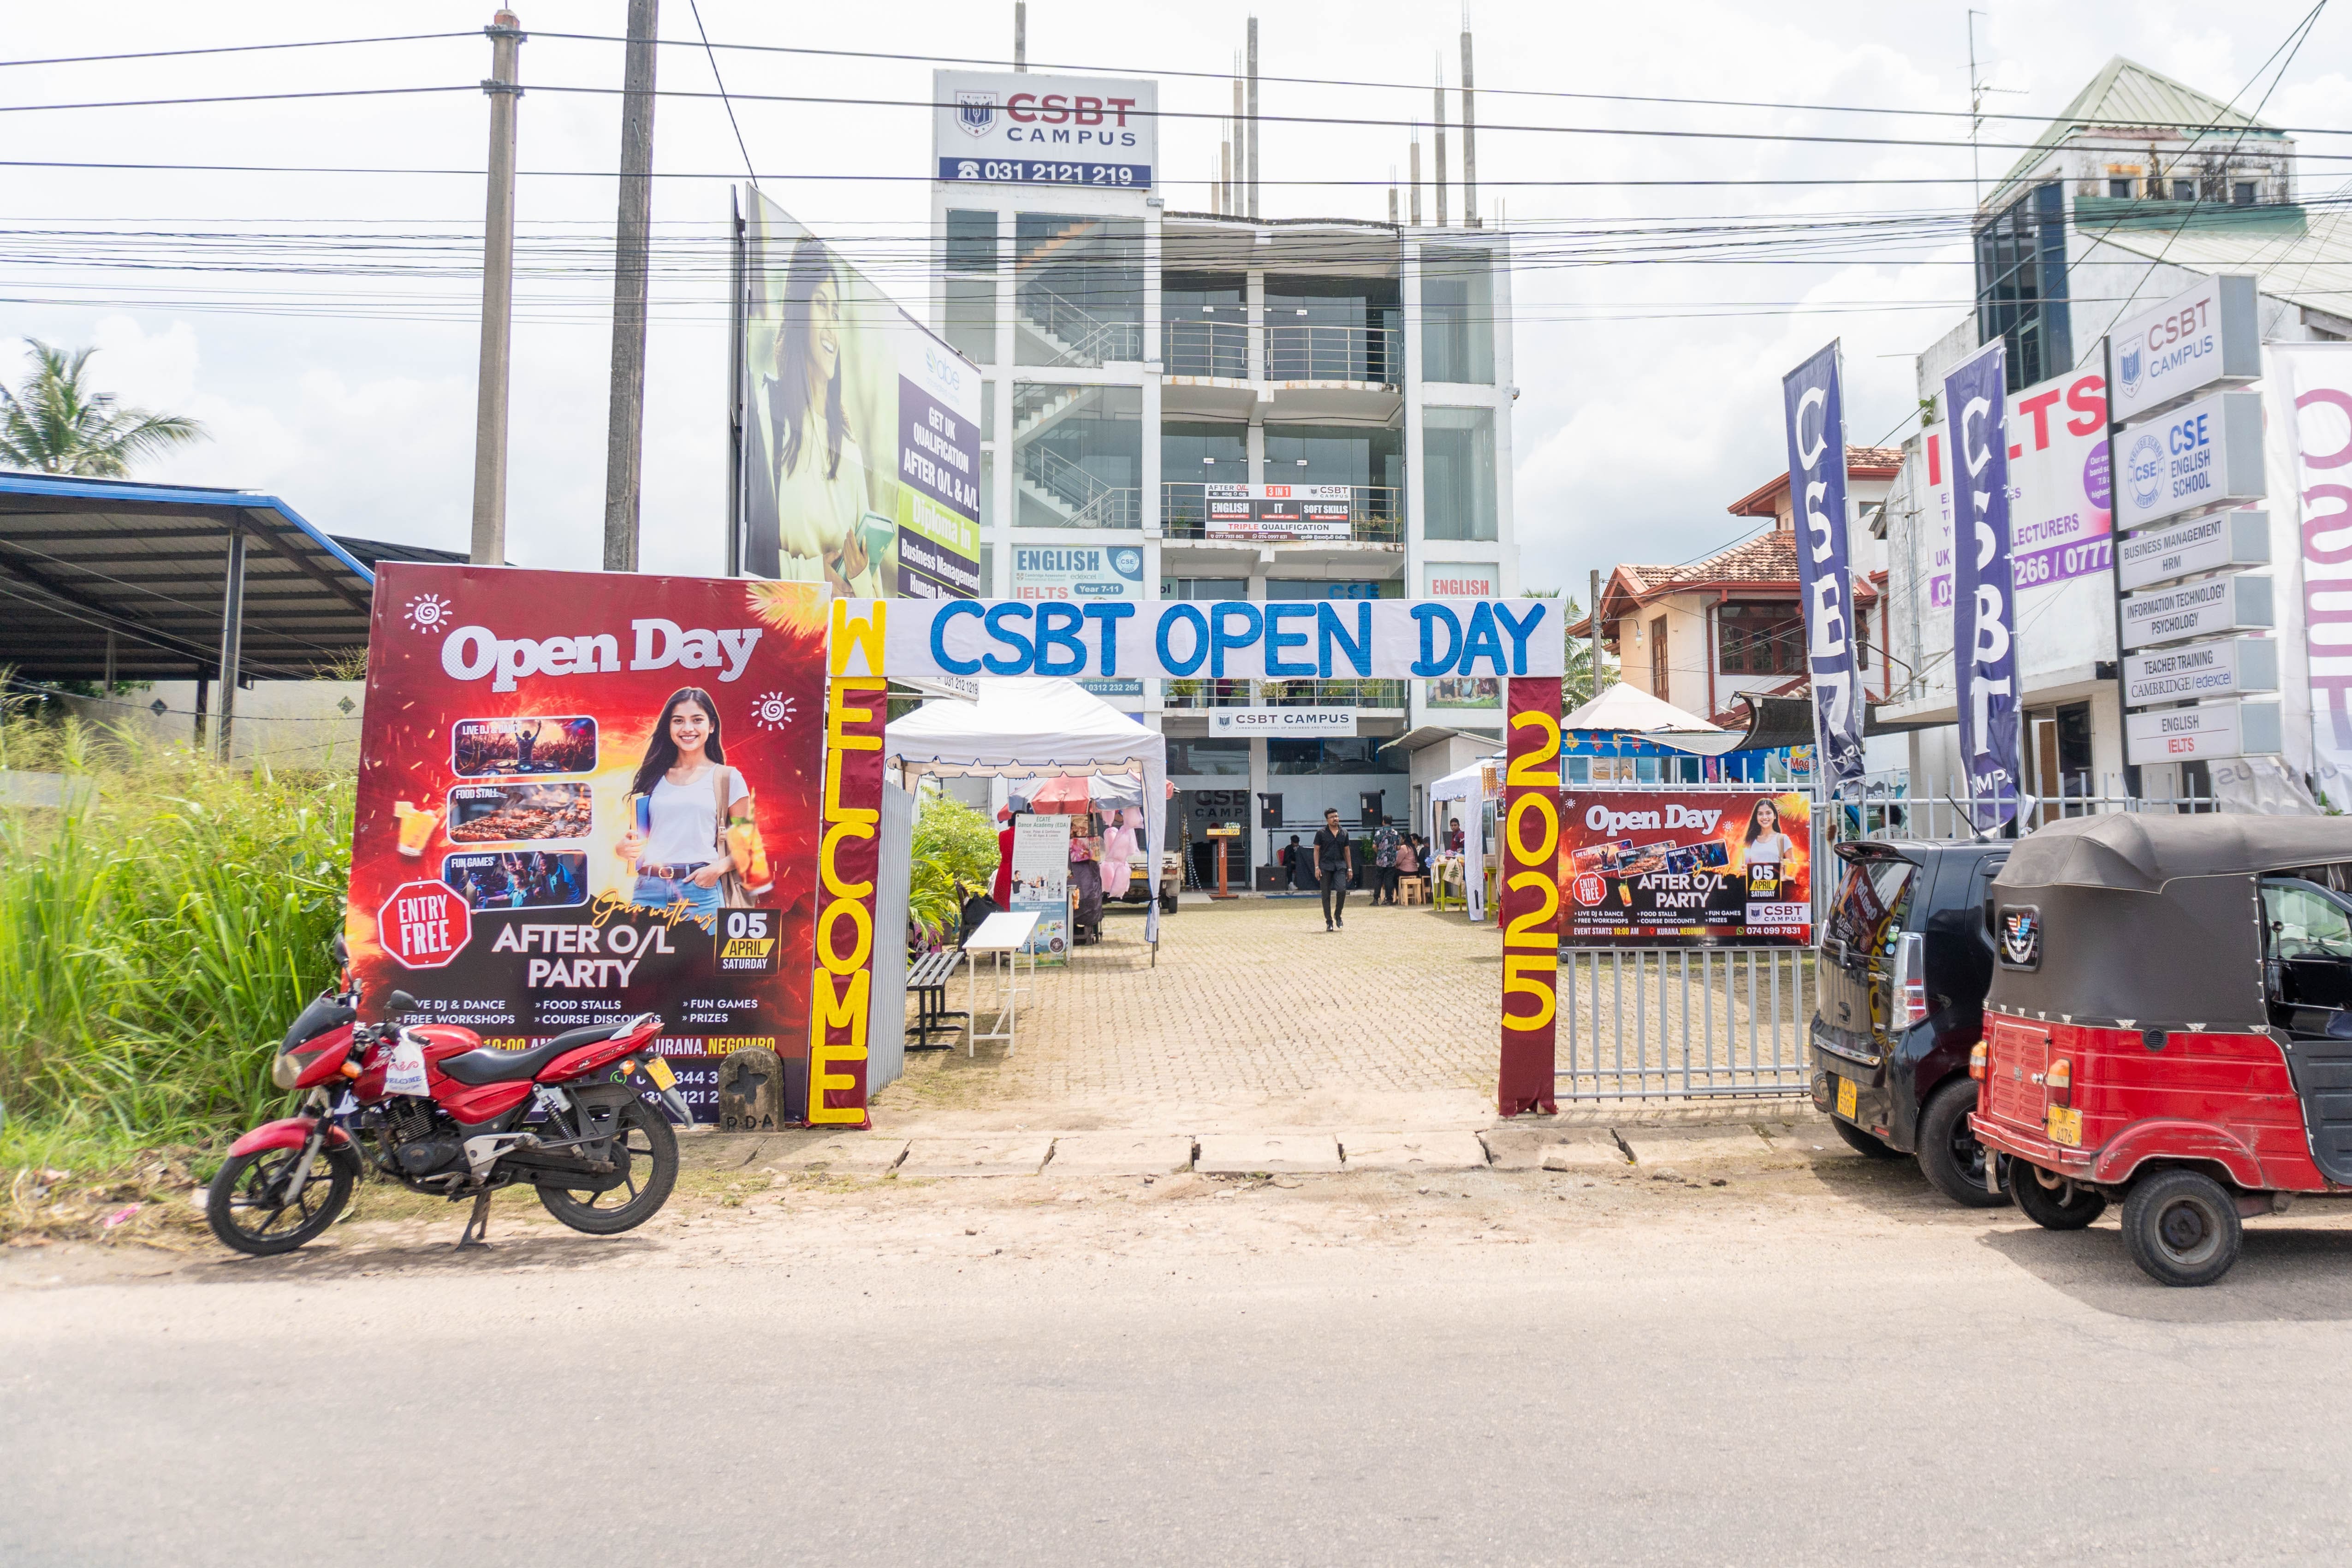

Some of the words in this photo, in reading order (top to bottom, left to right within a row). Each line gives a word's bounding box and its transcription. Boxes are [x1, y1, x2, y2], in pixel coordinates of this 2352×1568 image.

[1007, 93, 1135, 127] CSBT
[1007, 127, 1136, 146] CAMPUS
[985, 162, 1023, 180] 031
[1033, 165, 1083, 182] 2121
[1093, 166, 1133, 185] 219
[2149, 297, 2211, 351] CSBT
[2150, 335, 2214, 378] CAMPUS
[929, 406, 944, 433] GET
[945, 417, 956, 441] UK
[2169, 413, 2210, 457] CSE
[913, 422, 969, 474] QUALIFICATION
[2091, 456, 2100, 465] Our
[2171, 448, 2210, 474] ENGLISH
[903, 447, 935, 487] AFTER
[937, 468, 953, 498] O/L
[955, 478, 962, 503] &
[963, 484, 979, 512] A/L
[2090, 468, 2103, 477] band
[2098, 476, 2107, 485] 7.0
[2135, 462, 2157, 482] CSE
[1268, 487, 1273, 496] 3
[1275, 487, 1283, 496] IN
[1285, 487, 1289, 496] 1
[2172, 470, 2211, 499] SCHOOL
[1212, 502, 1249, 513] ENGLISH
[1274, 503, 1283, 514] IT
[1303, 505, 1322, 514] SOFT
[1323, 505, 1348, 514] SKILLS
[913, 494, 957, 545] Diploma
[961, 521, 971, 550] in
[2013, 513, 2079, 546] LECTURERS
[2124, 536, 2162, 560] BUSINESS
[2163, 520, 2222, 550] MANAGEMENT
[901, 538, 936, 571] Business
[1017, 550, 1099, 571] ENGLISH
[2162, 555, 2181, 571] HRM
[2016, 554, 2049, 586] 266
[909, 573, 936, 599] Human
[1017, 587, 1068, 599] IELTS
[1328, 584, 1379, 600] CSE
[1432, 579, 1489, 595] ENGLISH
[2127, 596, 2174, 619] INFORMATION
[2175, 583, 2226, 608] TECHNOLOGY
[2151, 612, 2199, 635] PSYCHOLOGY
[930, 600, 1135, 677] CSBT
[1155, 601, 1372, 678] OPEN
[1409, 601, 1546, 677] DAY
[440, 625, 620, 693] Open
[630, 618, 762, 682] Day
[2144, 657, 2176, 675] TEACHER
[2177, 650, 2213, 669] TRAINING
[944, 677, 954, 687] 031
[956, 677, 965, 690] 212
[966, 680, 978, 695] 1219
[1236, 715, 1277, 724] CSBT
[1284, 714, 1349, 723] CAMPUS
[2162, 714, 2199, 732] ENGLISH
[462, 725, 479, 735] LIVE
[480, 725, 490, 734] DJ
[2168, 737, 2194, 754] IELTS
[456, 789, 475, 799] FOOD
[475, 788, 499, 798] STALL
[1586, 805, 1661, 837] Open
[1664, 803, 1722, 835] Day
[451, 858, 467, 868] FUN
[467, 856, 493, 867] GAMES
[808, 599, 887, 1124] WELCOME
[1501, 710, 1561, 1032] 2025
[1752, 865, 1774, 880] 05
[1579, 877, 1598, 888] ENTRY
[1638, 874, 1690, 890] AFTER
[1694, 874, 1728, 892] O/L
[1754, 881, 1773, 890] APRIL
[1581, 886, 1600, 902] FREE
[1656, 892, 1710, 908] PARTY
[398, 894, 448, 923] ENTRY
[591, 888, 645, 928] Join
[649, 897, 699, 932] with
[693, 911, 716, 931] us
[1764, 906, 1803, 915] CSBT
[727, 912, 768, 939] 05
[400, 919, 452, 957] FREE
[492, 922, 600, 953] AFTER
[607, 925, 675, 959] O/L
[729, 940, 765, 956] APRIL
[528, 957, 639, 988] PARTY
[723, 958, 768, 969] SATURDAY
[434, 1000, 447, 1011] DJ
[451, 1000, 460, 1010] &
[463, 1000, 506, 1010] DANCE
[543, 1000, 577, 1010] FOOD
[581, 1000, 622, 1010] STALLS
[691, 999, 715, 1009] FUN
[718, 999, 758, 1009] GAMES
[404, 1015, 433, 1024] FREE
[436, 1014, 515, 1024] WORKSHOPS
[542, 1014, 589, 1024] COURSE
[690, 1014, 729, 1023] PRIZES
[2056, 1128, 2072, 1144] 6176
